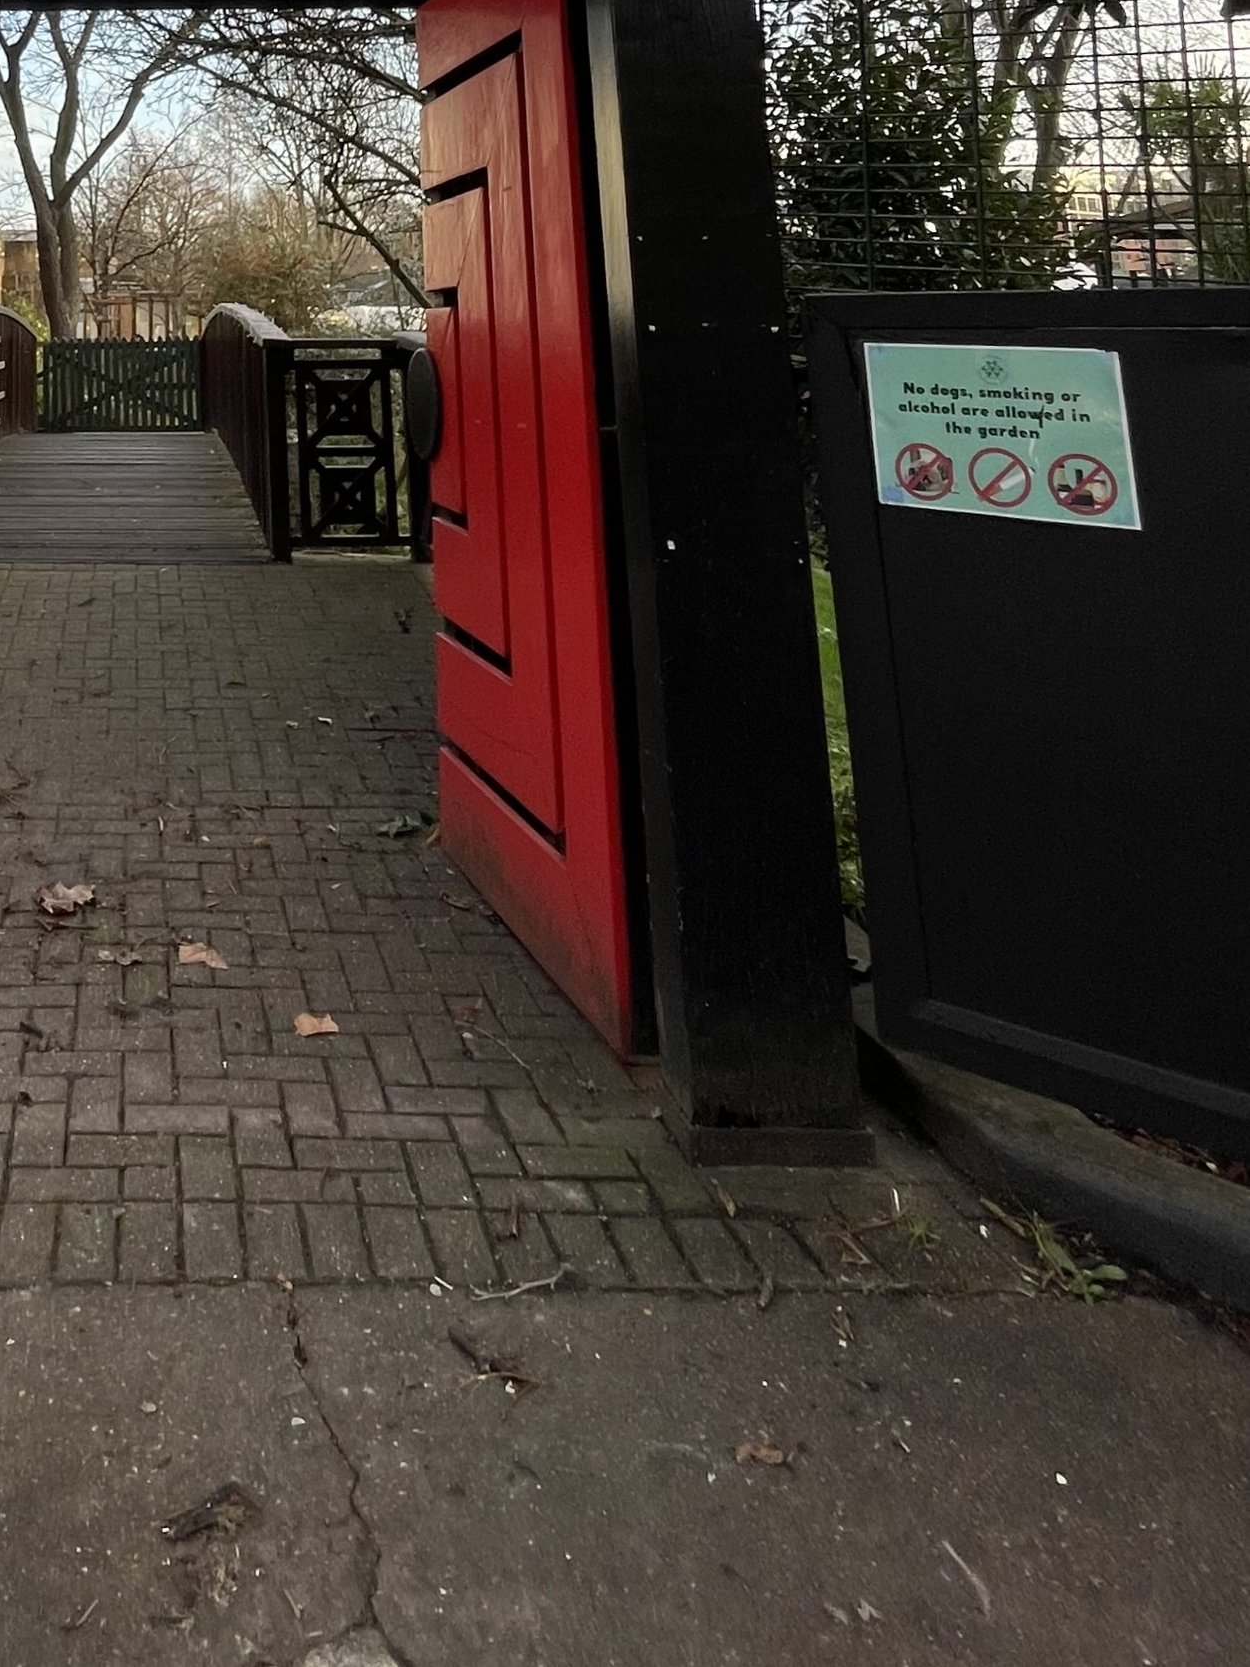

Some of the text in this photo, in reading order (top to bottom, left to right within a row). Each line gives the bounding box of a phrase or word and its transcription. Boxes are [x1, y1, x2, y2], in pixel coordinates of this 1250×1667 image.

[903, 382, 1081, 404] No dogs, smoking or
[898, 401, 1091, 422] alcohol are allowed in
[945, 422, 1040, 439] the garden
